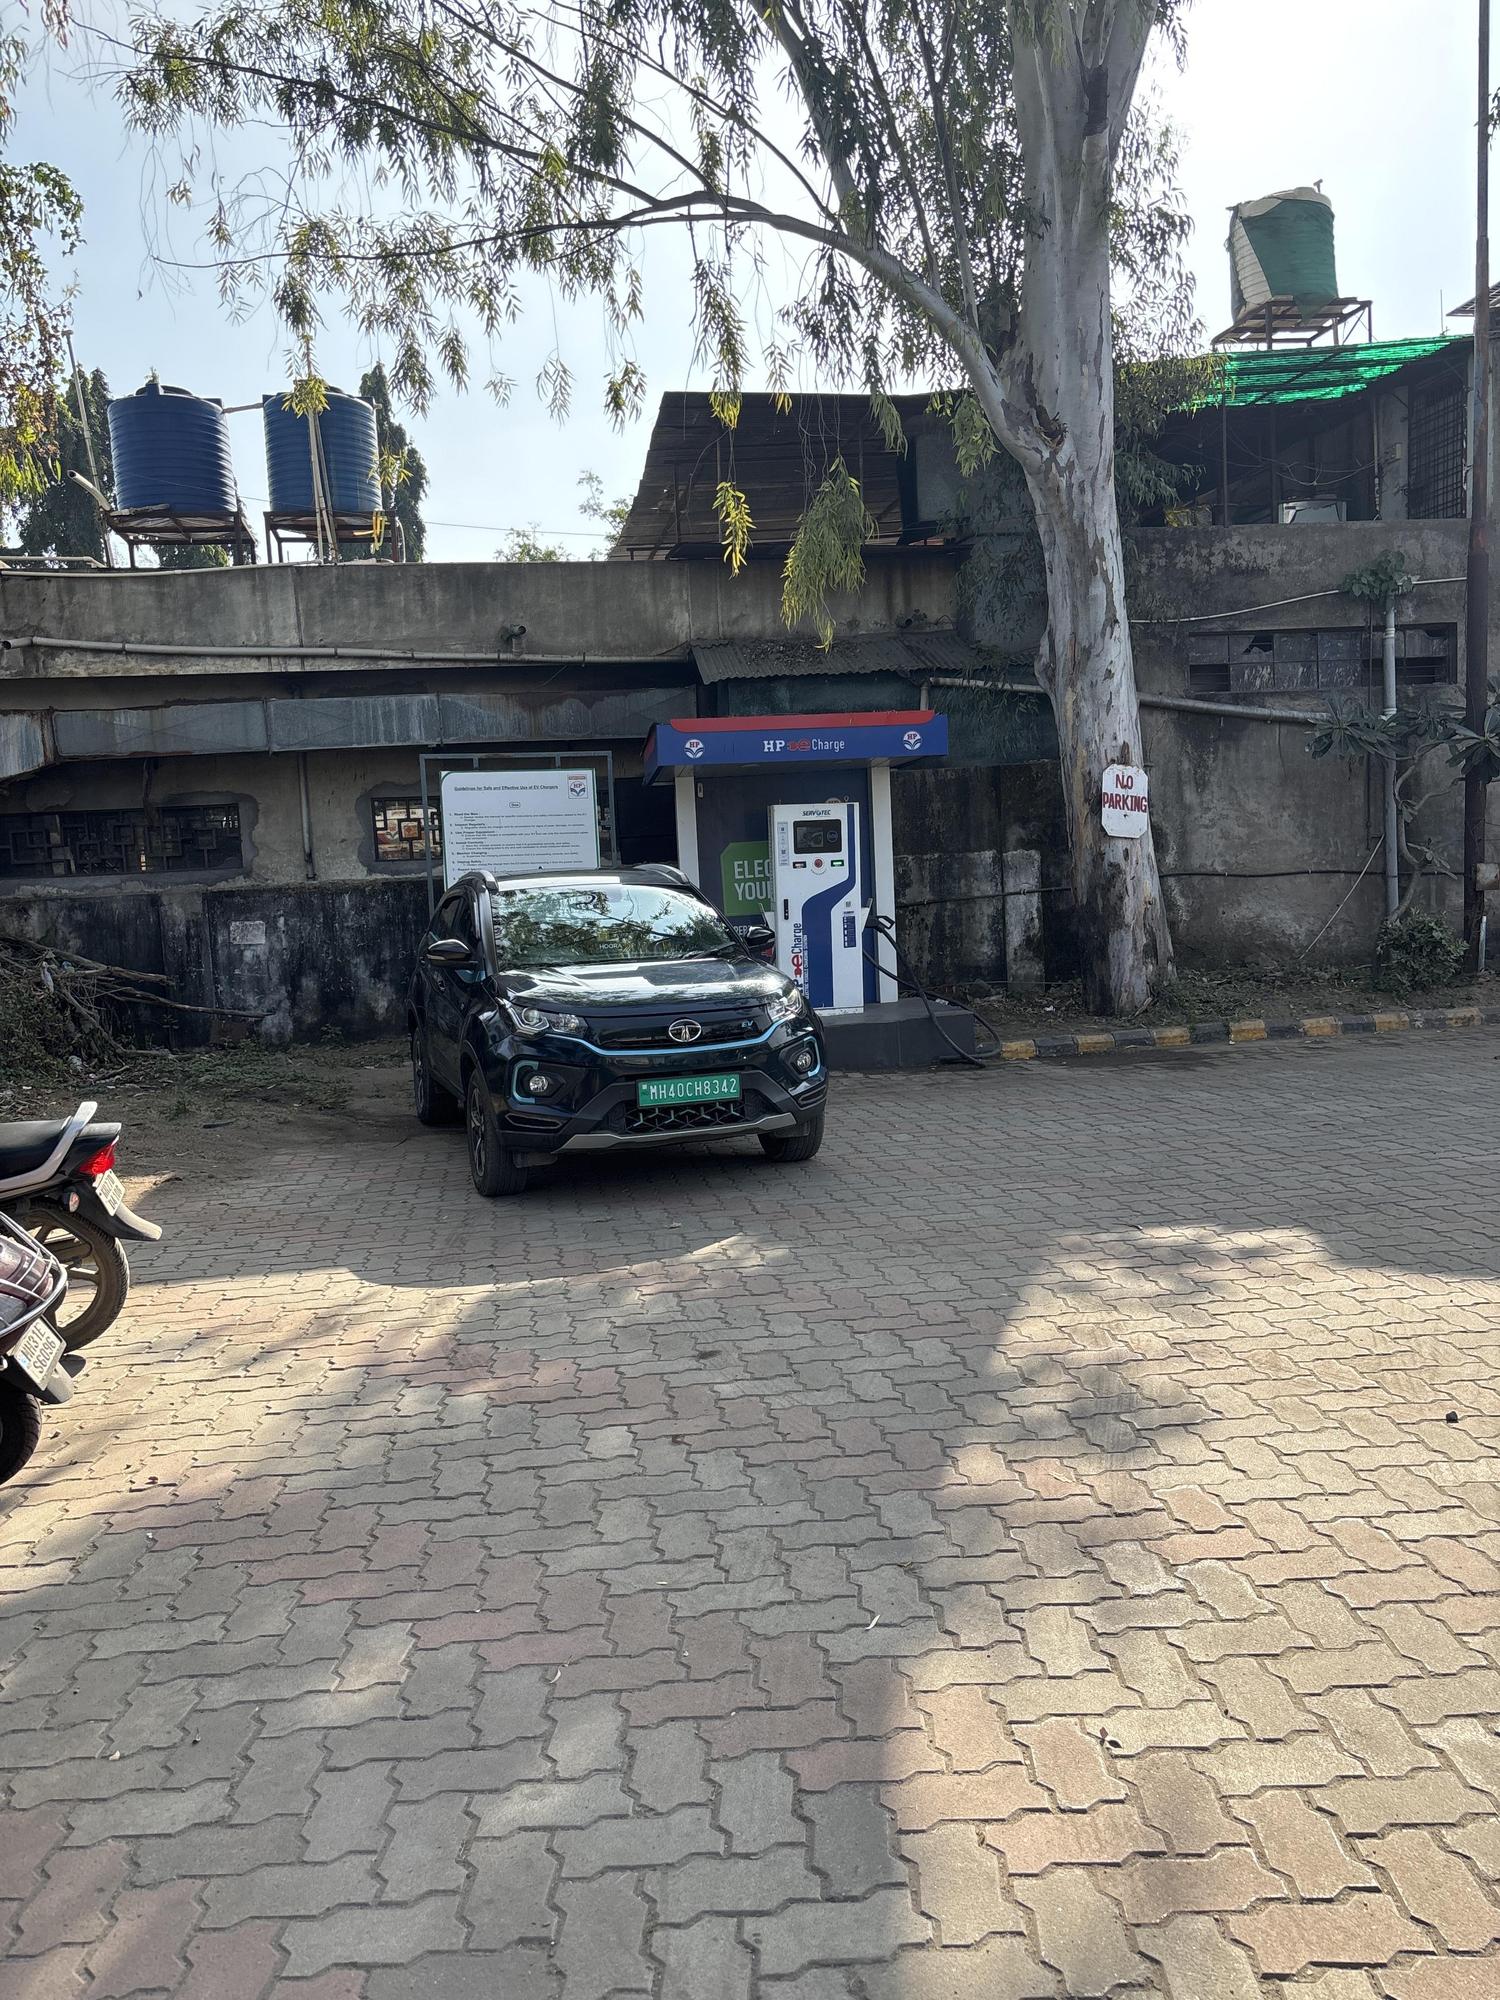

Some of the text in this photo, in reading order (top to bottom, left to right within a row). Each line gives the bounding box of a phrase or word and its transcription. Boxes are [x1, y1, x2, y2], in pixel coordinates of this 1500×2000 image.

[763, 740, 785, 752] HP
[1115, 774, 1134, 790] NO
[1103, 792, 1147, 813] PARKING
[650, 1079, 737, 1100] MH40CH8342
[33, 1336, 56, 1374] S6096
